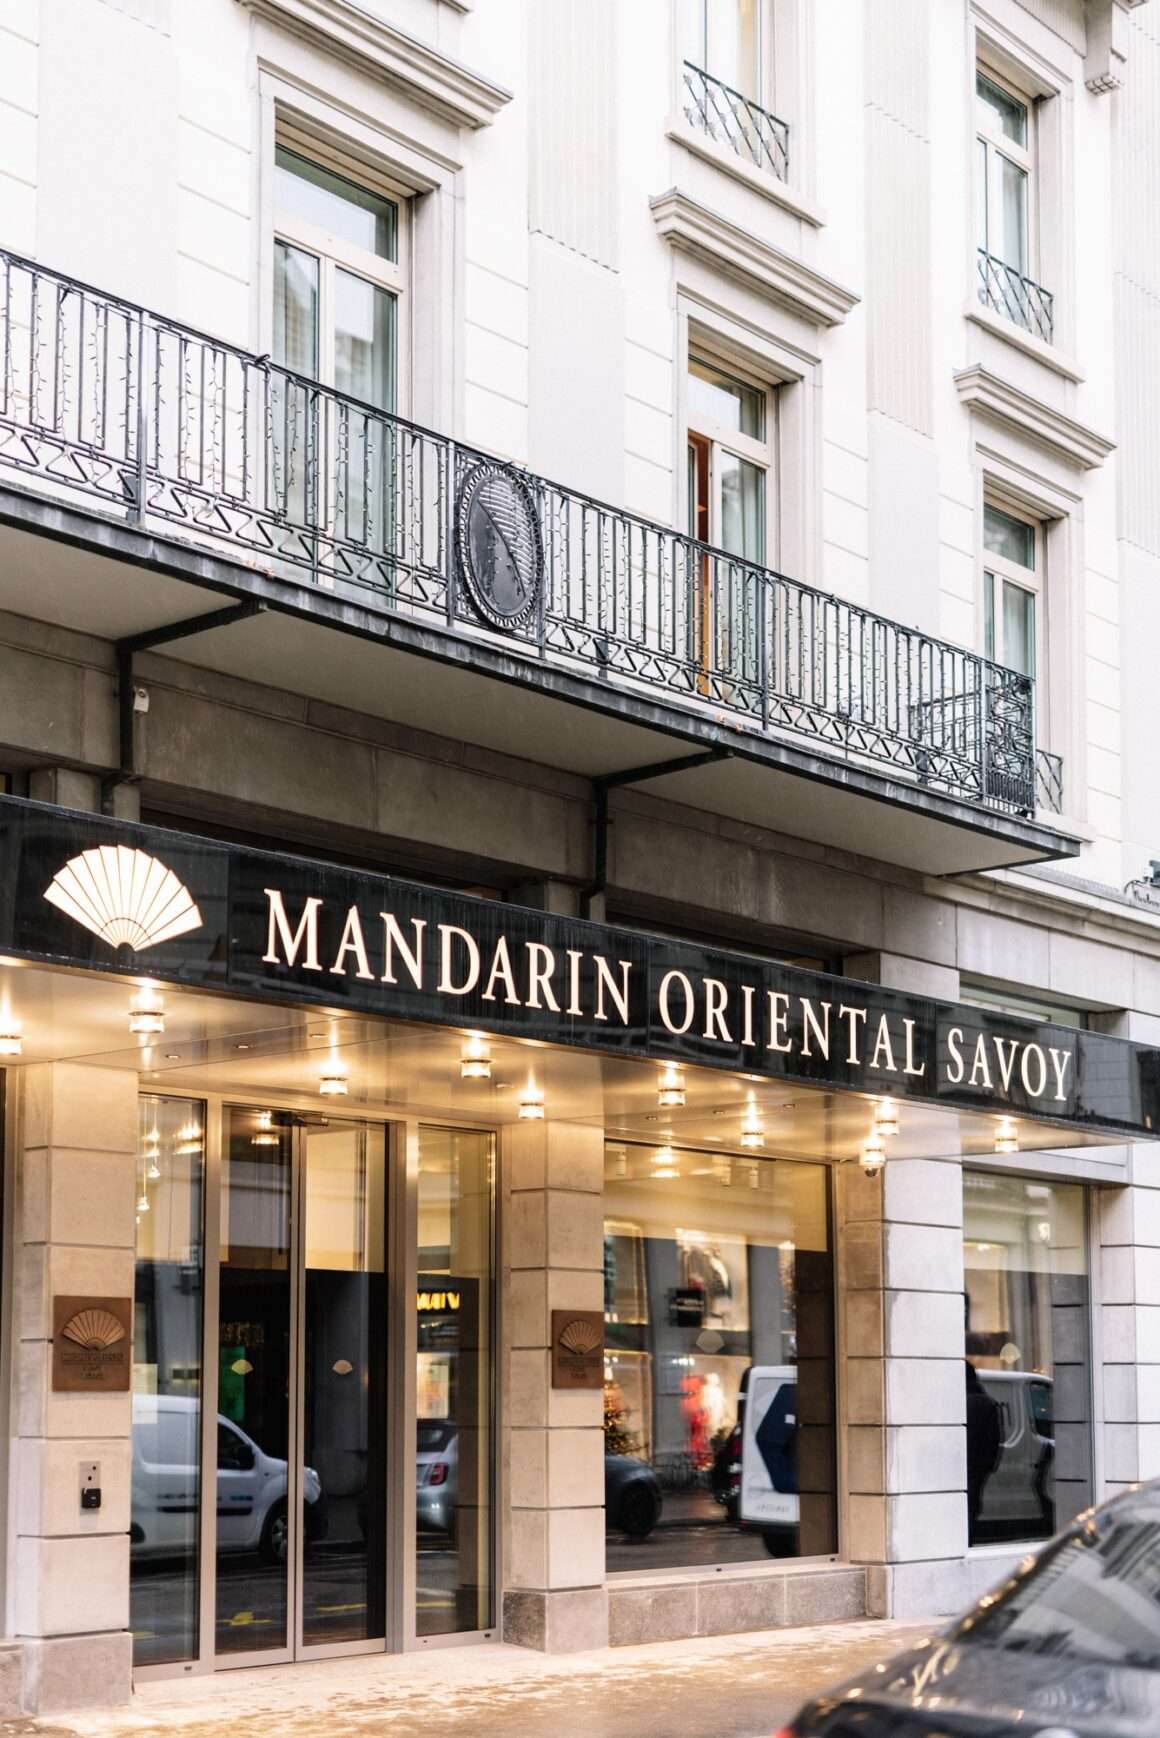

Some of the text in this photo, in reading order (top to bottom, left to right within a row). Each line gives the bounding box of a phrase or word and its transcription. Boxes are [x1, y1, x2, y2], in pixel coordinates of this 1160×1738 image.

[261, 888, 1073, 1102] MANDARIN ORIENTAL SAVOY
